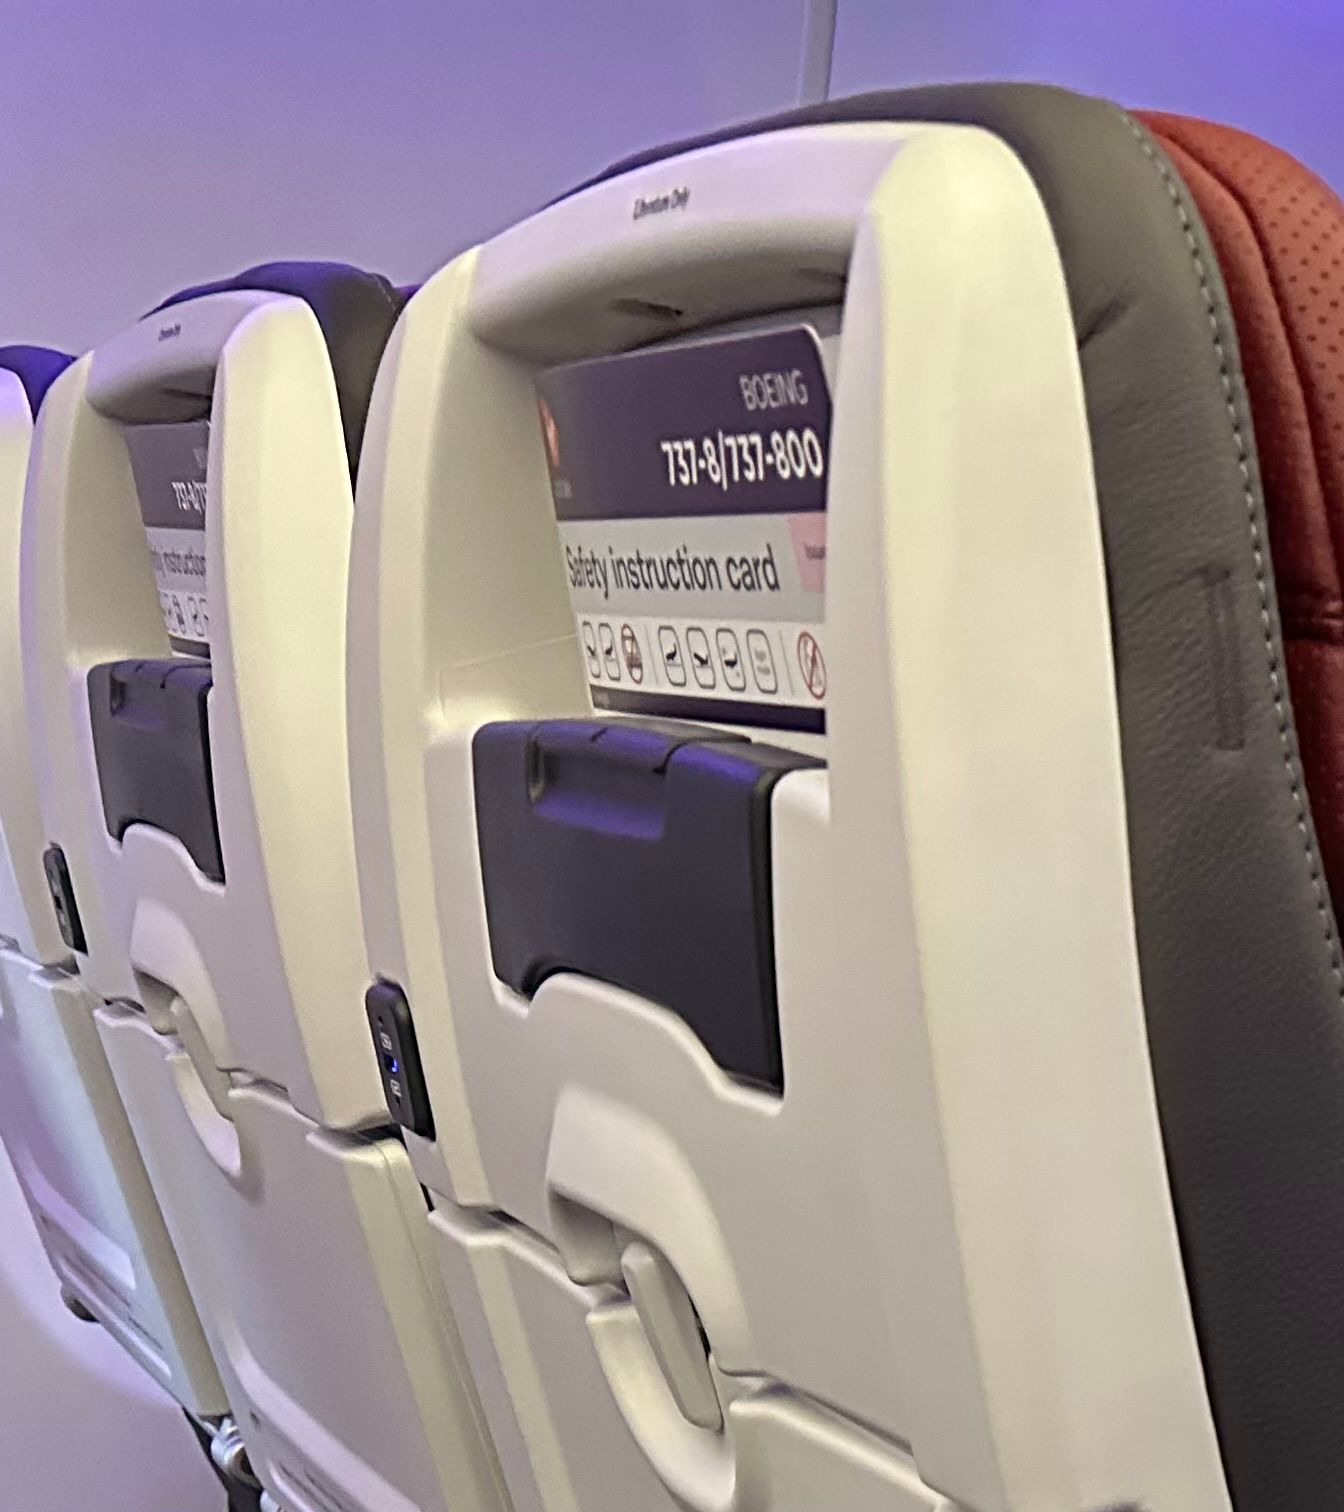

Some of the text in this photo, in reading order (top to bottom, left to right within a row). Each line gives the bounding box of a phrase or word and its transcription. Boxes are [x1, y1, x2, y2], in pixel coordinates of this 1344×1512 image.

[739, 369, 808, 411] BOEING
[660, 427, 824, 492] 737-8/737-800
[565, 543, 781, 599] Safety instruction card
